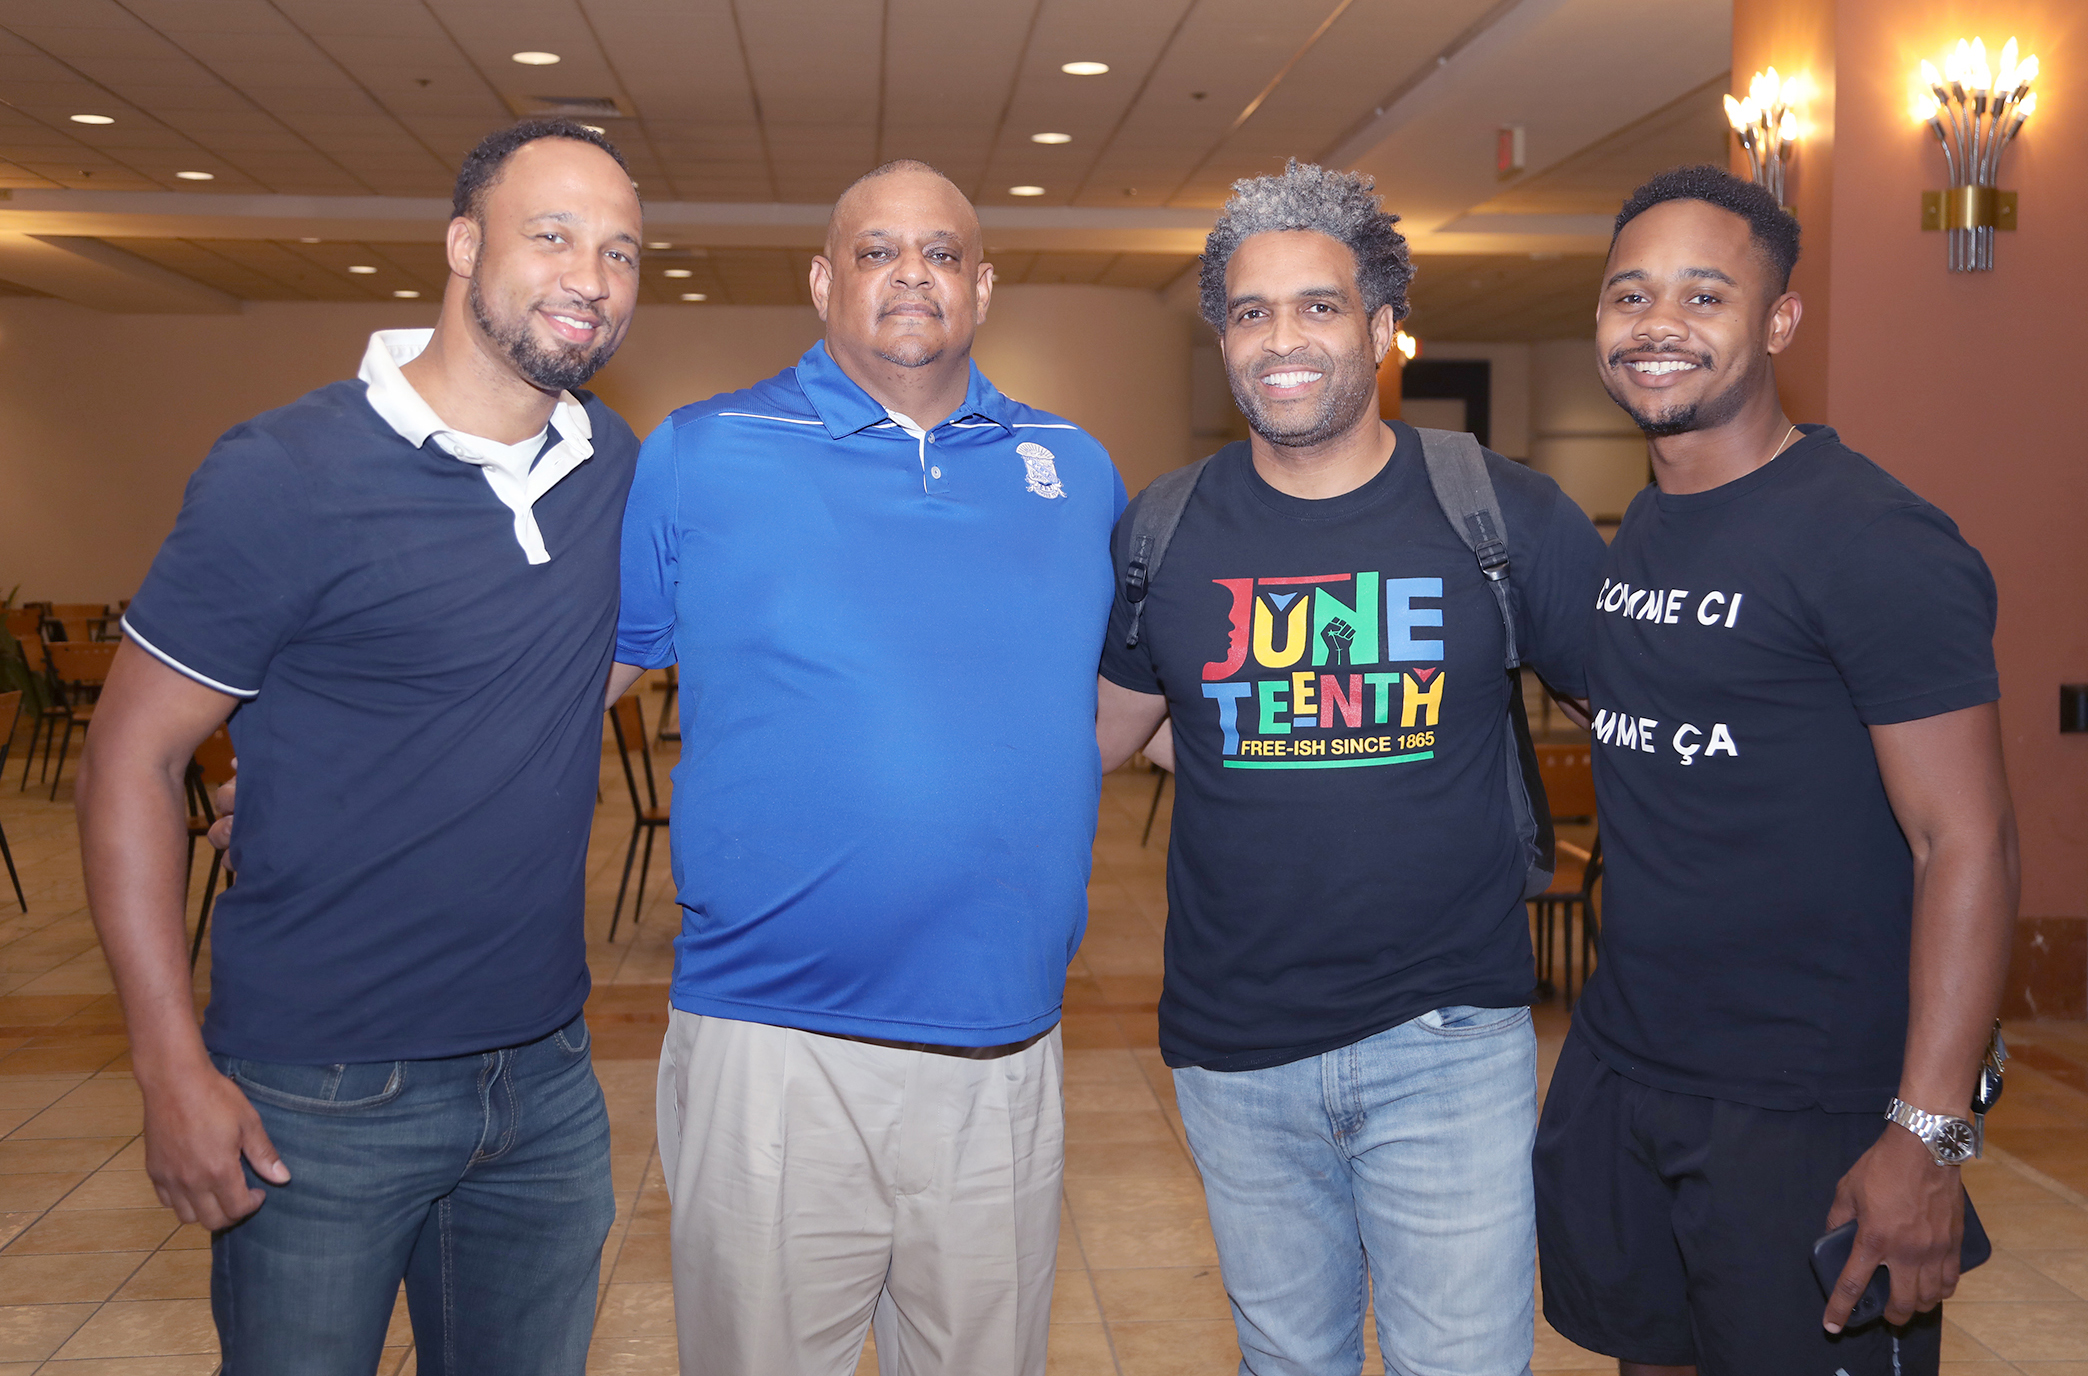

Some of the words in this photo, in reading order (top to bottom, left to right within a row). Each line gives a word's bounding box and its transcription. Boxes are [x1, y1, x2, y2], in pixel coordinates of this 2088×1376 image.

[1202, 571, 1444, 680] JUNE
[1697, 591, 1743, 628] CI
[1201, 668, 1445, 755] TEENTH
[1591, 709, 1658, 753] MME
[1672, 723, 1738, 766] ÇA
[1241, 739, 1325, 756] FREE-ISH
[1331, 736, 1391, 754] SINCE
[1397, 731, 1435, 750] 1865
